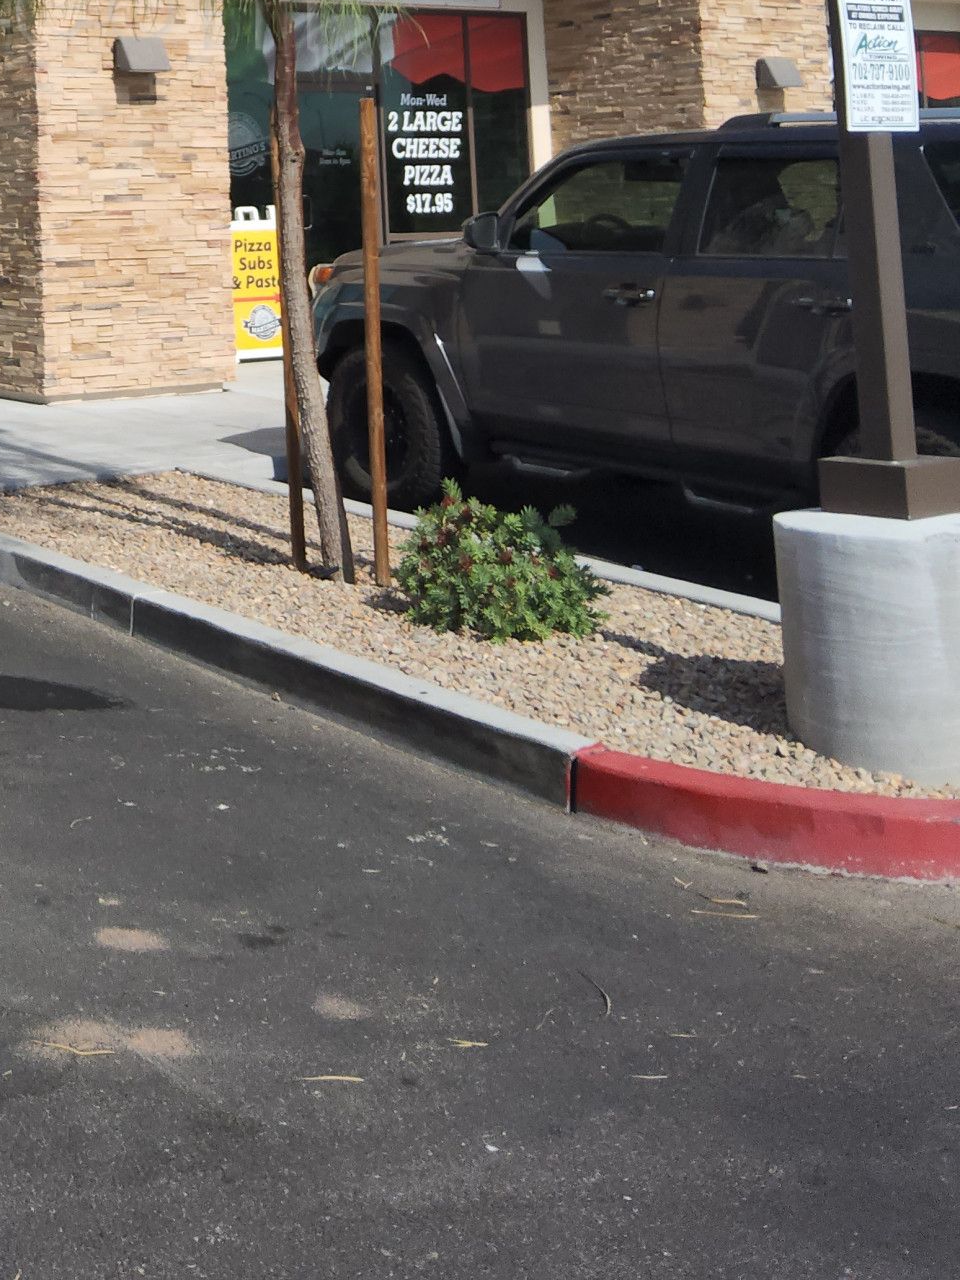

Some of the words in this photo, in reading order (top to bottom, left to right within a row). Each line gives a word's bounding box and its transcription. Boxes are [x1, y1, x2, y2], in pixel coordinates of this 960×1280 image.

[400, 93, 447, 107] Mon-Wed
[387, 111, 399, 132] 2
[401, 111, 463, 132] LARGE
[391, 137, 462, 159] CHEESE
[402, 164, 454, 186] PIZZA
[405, 192, 454, 214] $17.95
[234, 239, 272, 253] Pizza
[239, 257, 273, 271] Subs
[231, 276, 241, 290] &
